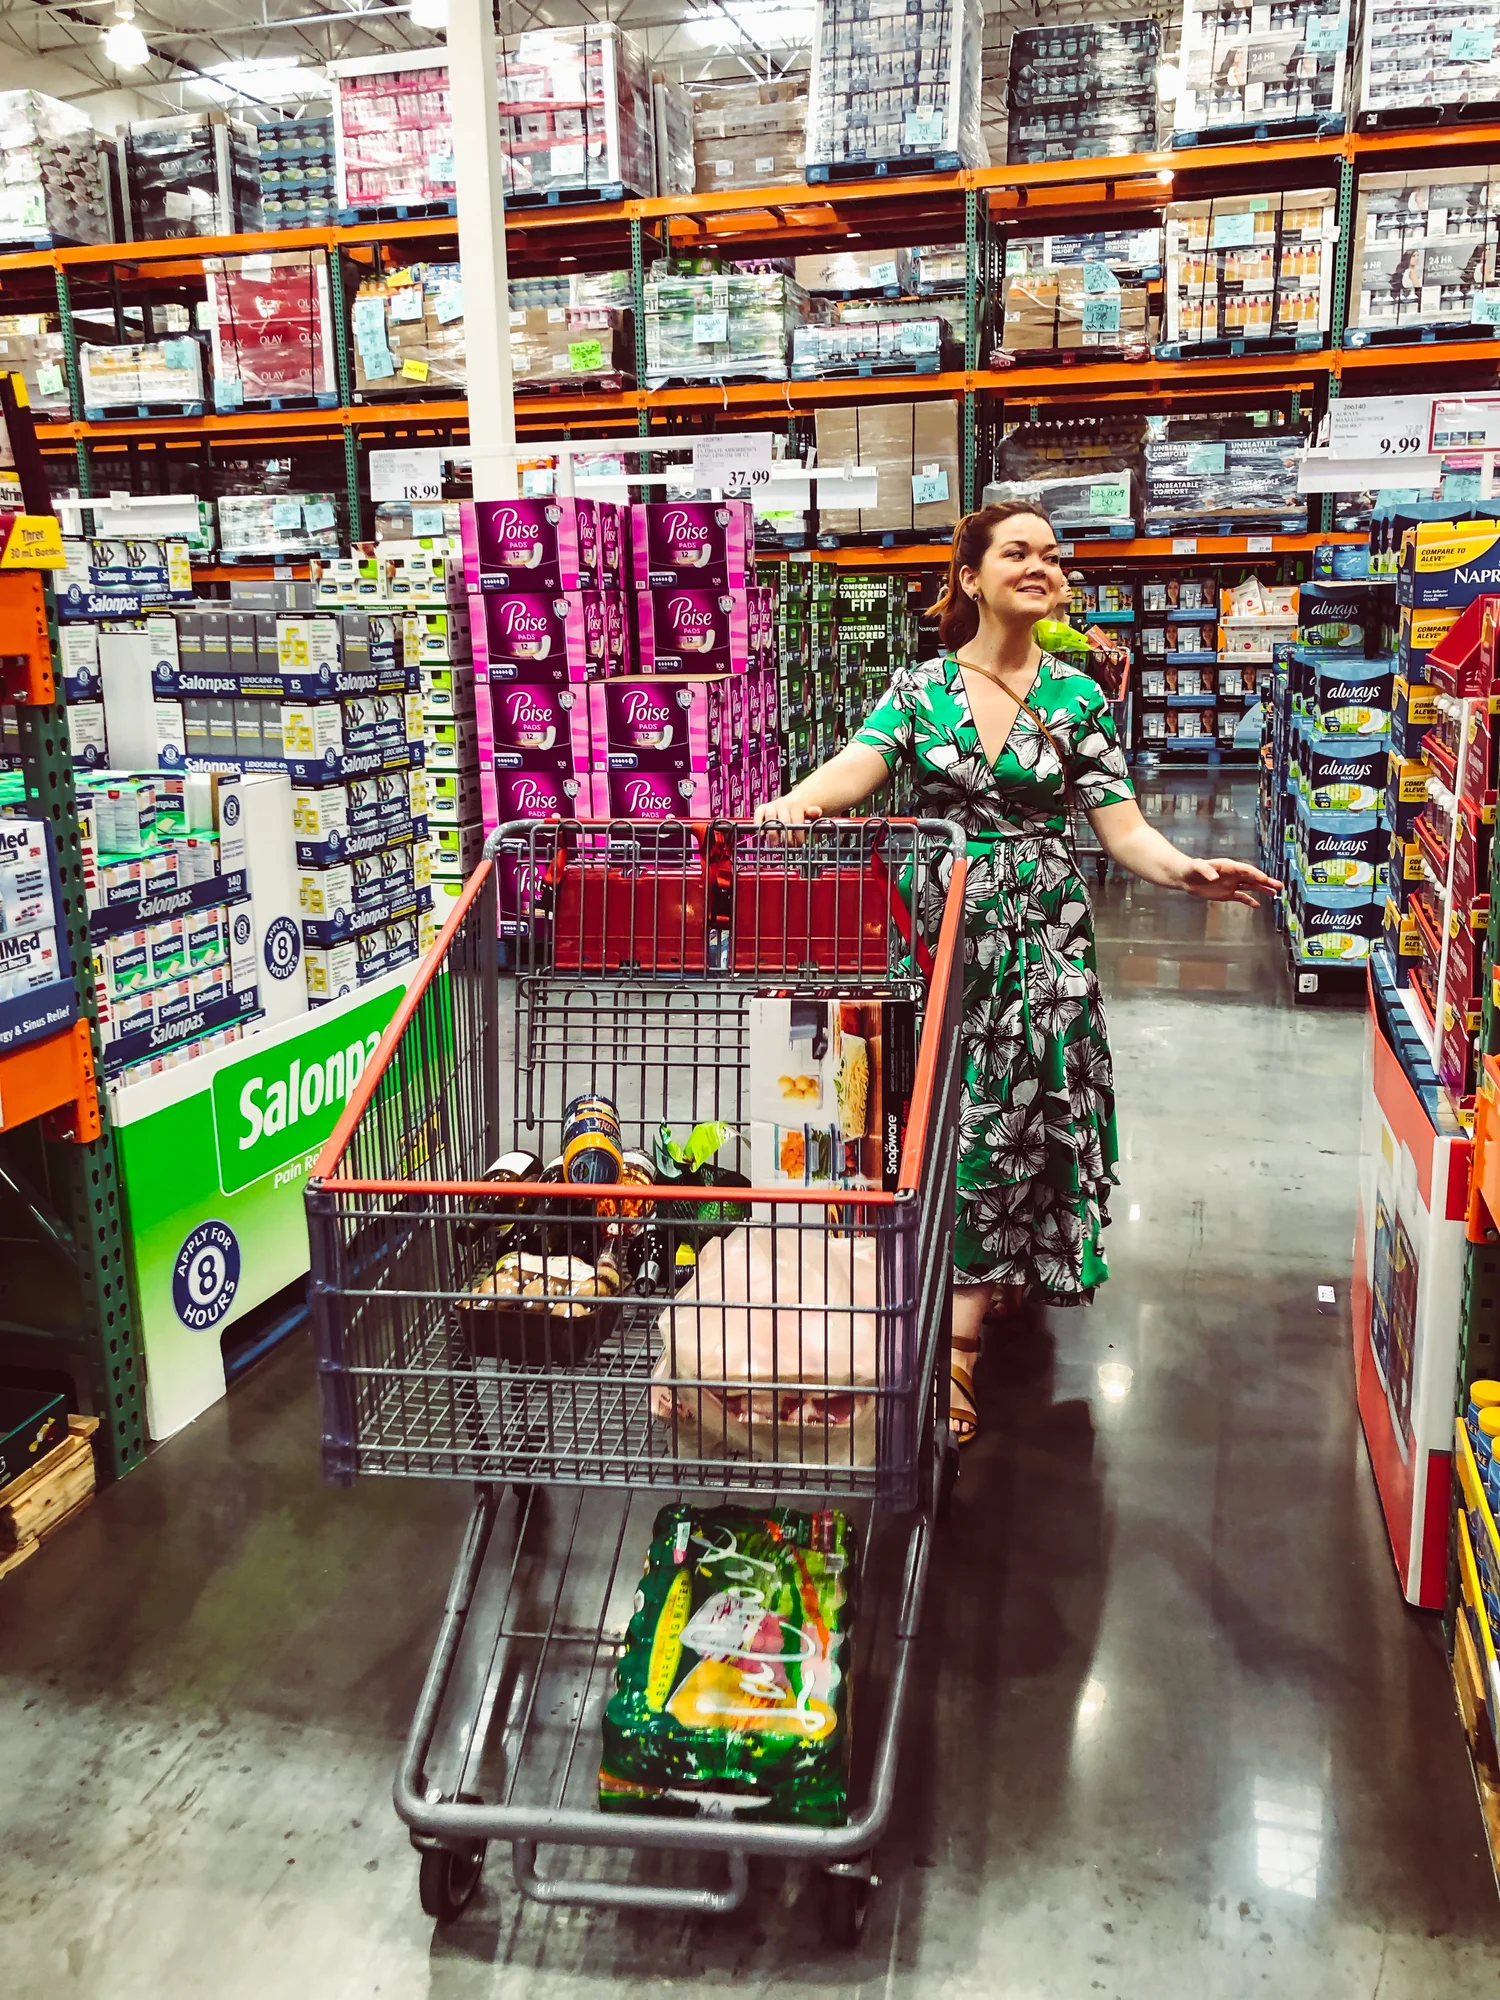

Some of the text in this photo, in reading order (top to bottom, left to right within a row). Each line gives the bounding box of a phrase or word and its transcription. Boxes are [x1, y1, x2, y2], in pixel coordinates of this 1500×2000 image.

[1428, 256, 1453, 265] 24 HR
[259, 335, 284, 346] OLAY
[260, 370, 285, 381] OLAY
[1231, 440, 1278, 448] UNBEATABLE
[1380, 437, 1420, 454] 9.99
[728, 470, 770, 486] 37.99
[404, 485, 439, 499] 18.99
[492, 508, 539, 543] Poise
[578, 512, 594, 540] Poise
[662, 510, 709, 543] Poise
[22, 530, 44, 541] Three
[10, 548, 20, 559] 30
[35, 548, 61, 557] Bottles
[98, 571, 126, 582] Salonpas
[131, 571, 158, 582] Salonpas
[1454, 568, 1500, 584] NAPR
[839, 590, 886, 599] TAILORED
[88, 595, 139, 614] Salonpas
[668, 597, 713, 629] Poise
[851, 599, 875, 612] FIT
[1311, 601, 1359, 619] always
[501, 601, 547, 635] Poise
[838, 632, 886, 640] TAILORED
[372, 647, 393, 657] Salonpas
[178, 674, 237, 693] Salonpas
[290, 680, 301, 689] 15
[336, 674, 415, 692] Salonpas 15
[1327, 682, 1381, 703] always
[506, 692, 552, 724] Poise
[622, 691, 670, 724] Poise
[349, 731, 374, 742] Salonpas
[376, 723, 398, 735] Salonpas
[294, 765, 305, 774] 15
[341, 748, 420, 774] Salonpas 15
[1319, 760, 1372, 780] always
[512, 779, 557, 811] Poise
[625, 780, 672, 812] Poise
[353, 808, 376, 822] Salonpas
[380, 800, 402, 814] Salonpas
[345, 823, 423, 855] Salonpas 15
[1315, 836, 1368, 856] always
[302, 846, 312, 857] 15
[148, 876, 175, 891] Salonpas
[384, 874, 405, 888] Salonpas
[109, 885, 139, 900] Salonpas
[136, 875, 241, 919] Salonpas 140
[358, 884, 380, 898] Salonpas
[350, 894, 427, 931] Salonpas 15
[1311, 910, 1363, 930] always
[191, 929, 217, 944] Salonpas
[267, 920, 297, 945] APPLY FOR
[307, 925, 317, 935] 15
[154, 940, 182, 956] Salonpas
[278, 936, 288, 960] 8
[389, 946, 410, 961] Salonpas
[116, 952, 144, 968] Salonpas
[270, 955, 298, 978] HOURS
[363, 958, 386, 973] Salonpas
[196, 988, 222, 1004] Salonpas
[161, 1001, 188, 1018] Salonpas
[15, 1005, 70, 1036] & Sinus Relief
[123, 1014, 151, 1032] Salonpas
[149, 991, 253, 1048] Salonpas 140
[886, 1114, 899, 1175] Snapware
[274, 1162, 301, 1189] Pain
[178, 1227, 232, 1277] APPLY FOR
[198, 1254, 217, 1296] 8
[183, 1280, 235, 1326] HOURS
